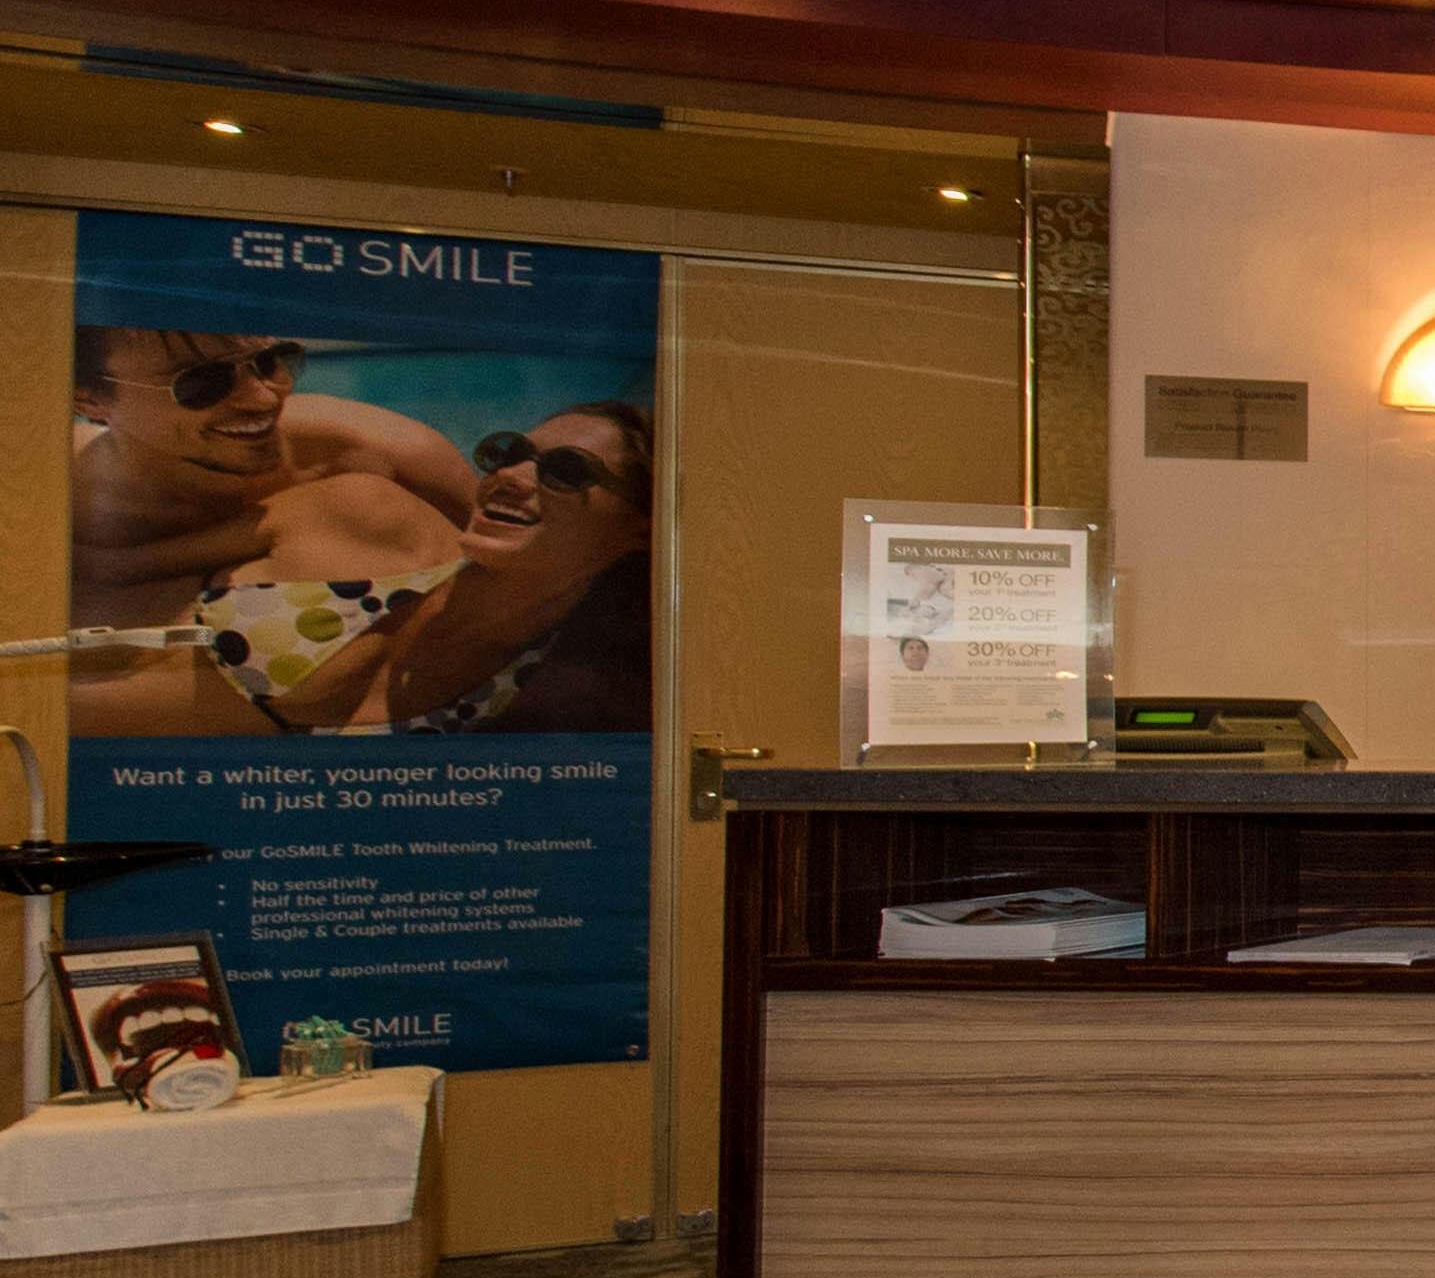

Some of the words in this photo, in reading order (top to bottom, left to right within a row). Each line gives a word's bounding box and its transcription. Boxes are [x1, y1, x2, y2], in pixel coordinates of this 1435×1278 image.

[232, 230, 344, 272] GO
[360, 240, 533, 287] SMILE
[893, 545, 920, 557] SPA
[924, 547, 974, 559] MORE.
[977, 548, 1012, 560] SAVE
[969, 570, 1013, 586] 10%
[1018, 573, 1056, 587] OFF
[968, 605, 1016, 622] 20%
[1020, 608, 1057, 622] OFF
[968, 642, 1016, 657] 30%
[1020, 644, 1057, 658] OFF
[113, 766, 185, 786] Want
[196, 771, 213, 785] a
[223, 765, 315, 787] whiter,
[326, 767, 435, 786] younger
[447, 761, 541, 784] looking
[551, 761, 618, 780] smile
[241, 791, 265, 810] in
[274, 790, 325, 813] just
[336, 789, 372, 808] 30
[382, 787, 503, 808] minutes?
[222, 848, 253, 859] our
[261, 844, 345, 858] GoSMILE
[352, 842, 402, 856] Tooth
[409, 840, 498, 856] Whitening
[505, 838, 597, 852] Treatment.
[252, 879, 278, 892] No
[284, 876, 379, 892] sensitivity
[252, 895, 289, 908] Half
[297, 893, 327, 906] the
[333, 891, 373, 905] time
[380, 890, 414, 904] and
[419, 888, 464, 905] price
[470, 887, 487, 901] of
[493, 886, 539, 900] other
[252, 908, 365, 926] professional
[371, 905, 458, 922] whitening
[464, 902, 535, 918] systems
[251, 925, 308, 942] Single
[315, 924, 328, 937] &
[334, 922, 397, 939] Couple
[403, 918, 502, 934] treatments
[508, 915, 584, 931] available
[226, 968, 273, 982] Book
[281, 967, 322, 982] your
[330, 961, 446, 979] appointment
[452, 956, 509, 973] today!
[352, 1013, 452, 1039] SMILE
